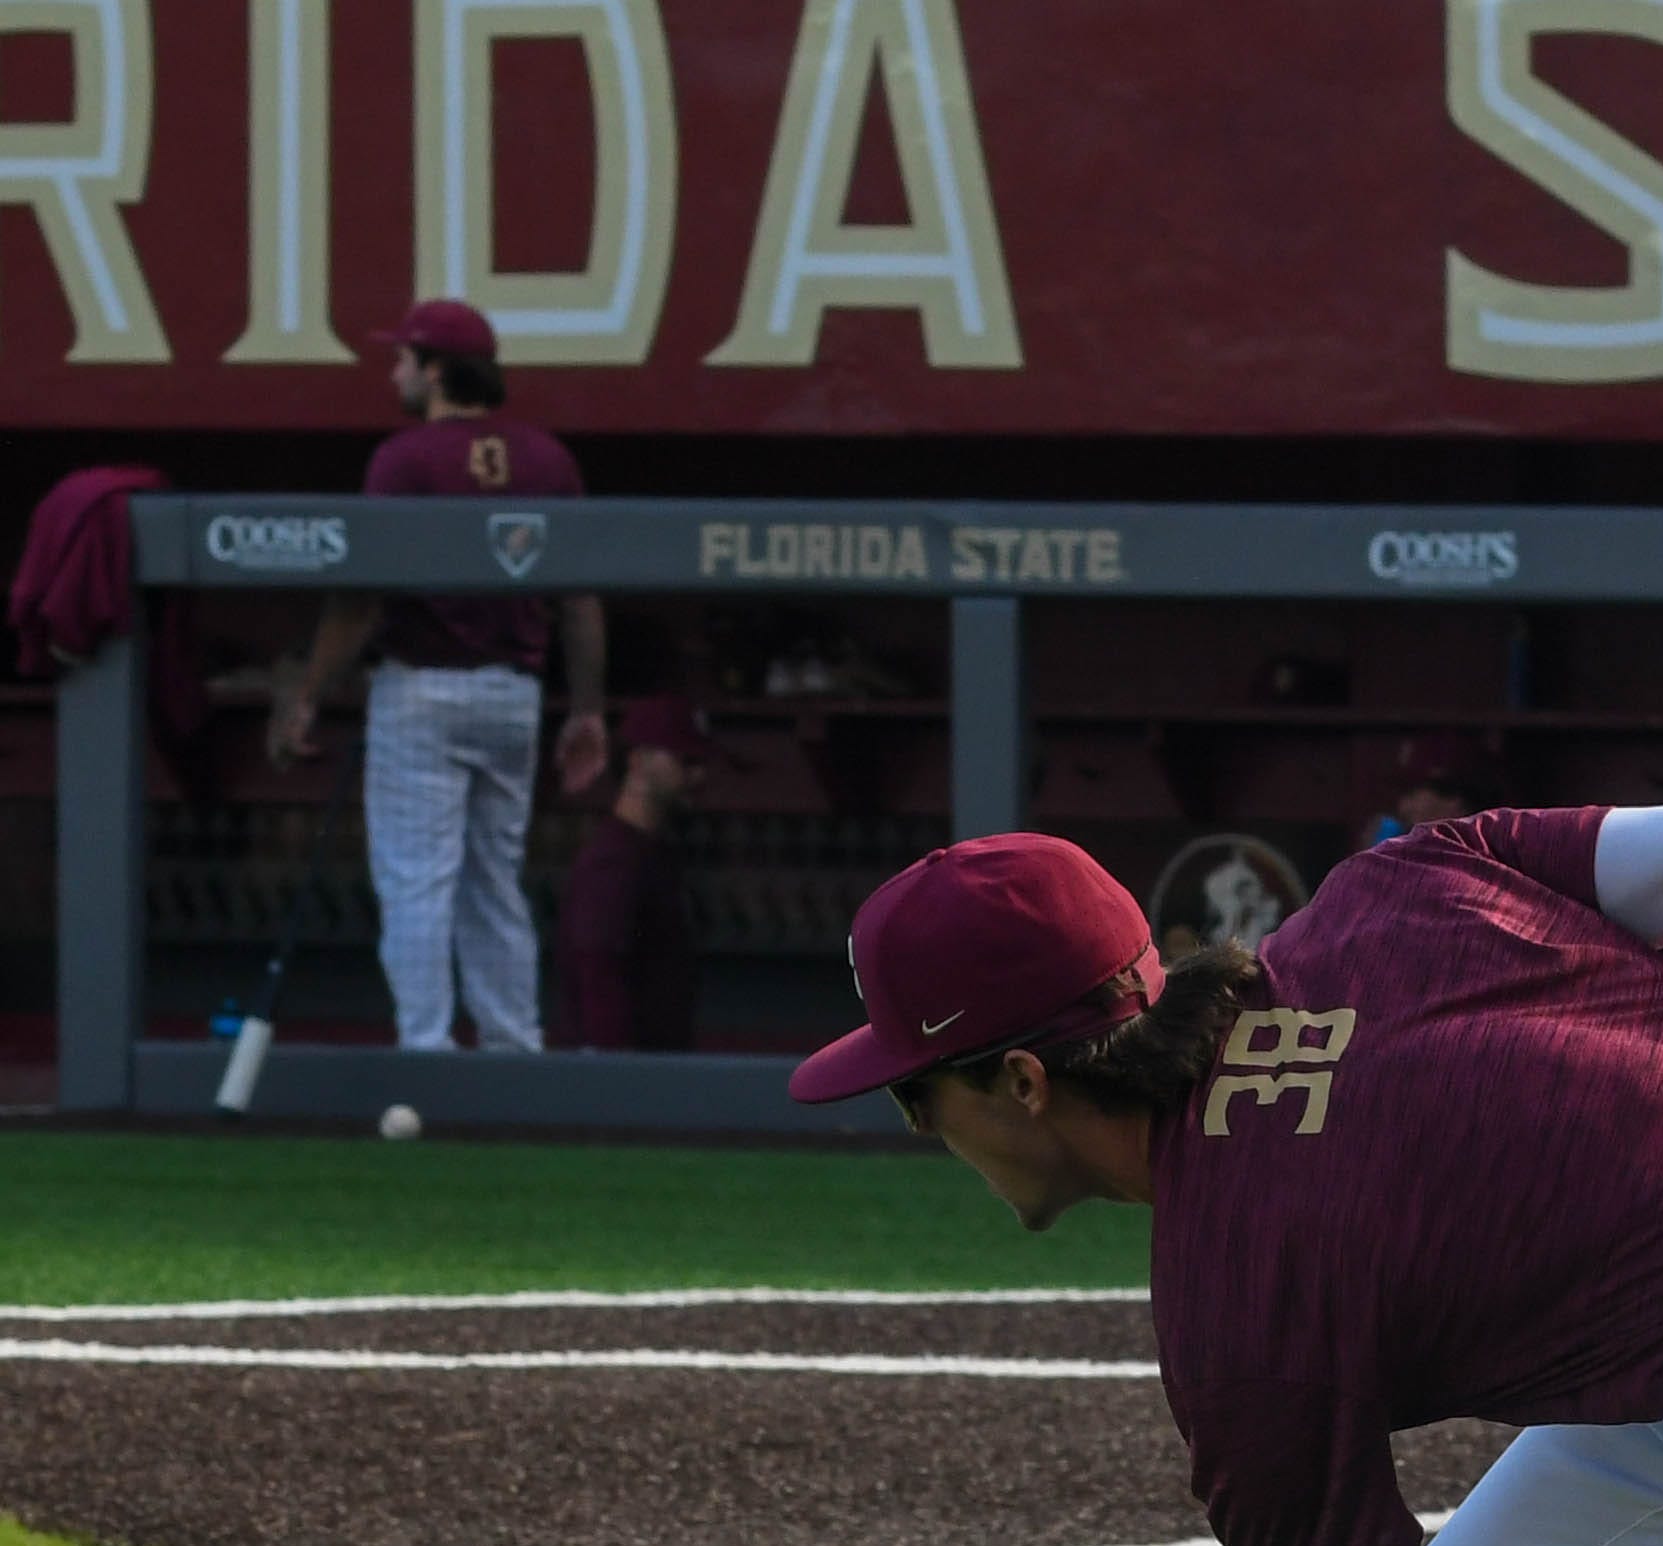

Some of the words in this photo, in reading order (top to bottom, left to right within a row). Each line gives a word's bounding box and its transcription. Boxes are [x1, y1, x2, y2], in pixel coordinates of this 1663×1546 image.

[702, 523, 928, 579] FLORIDA
[950, 527, 1123, 584] STATE
[1203, 1007, 1357, 1137] 38
